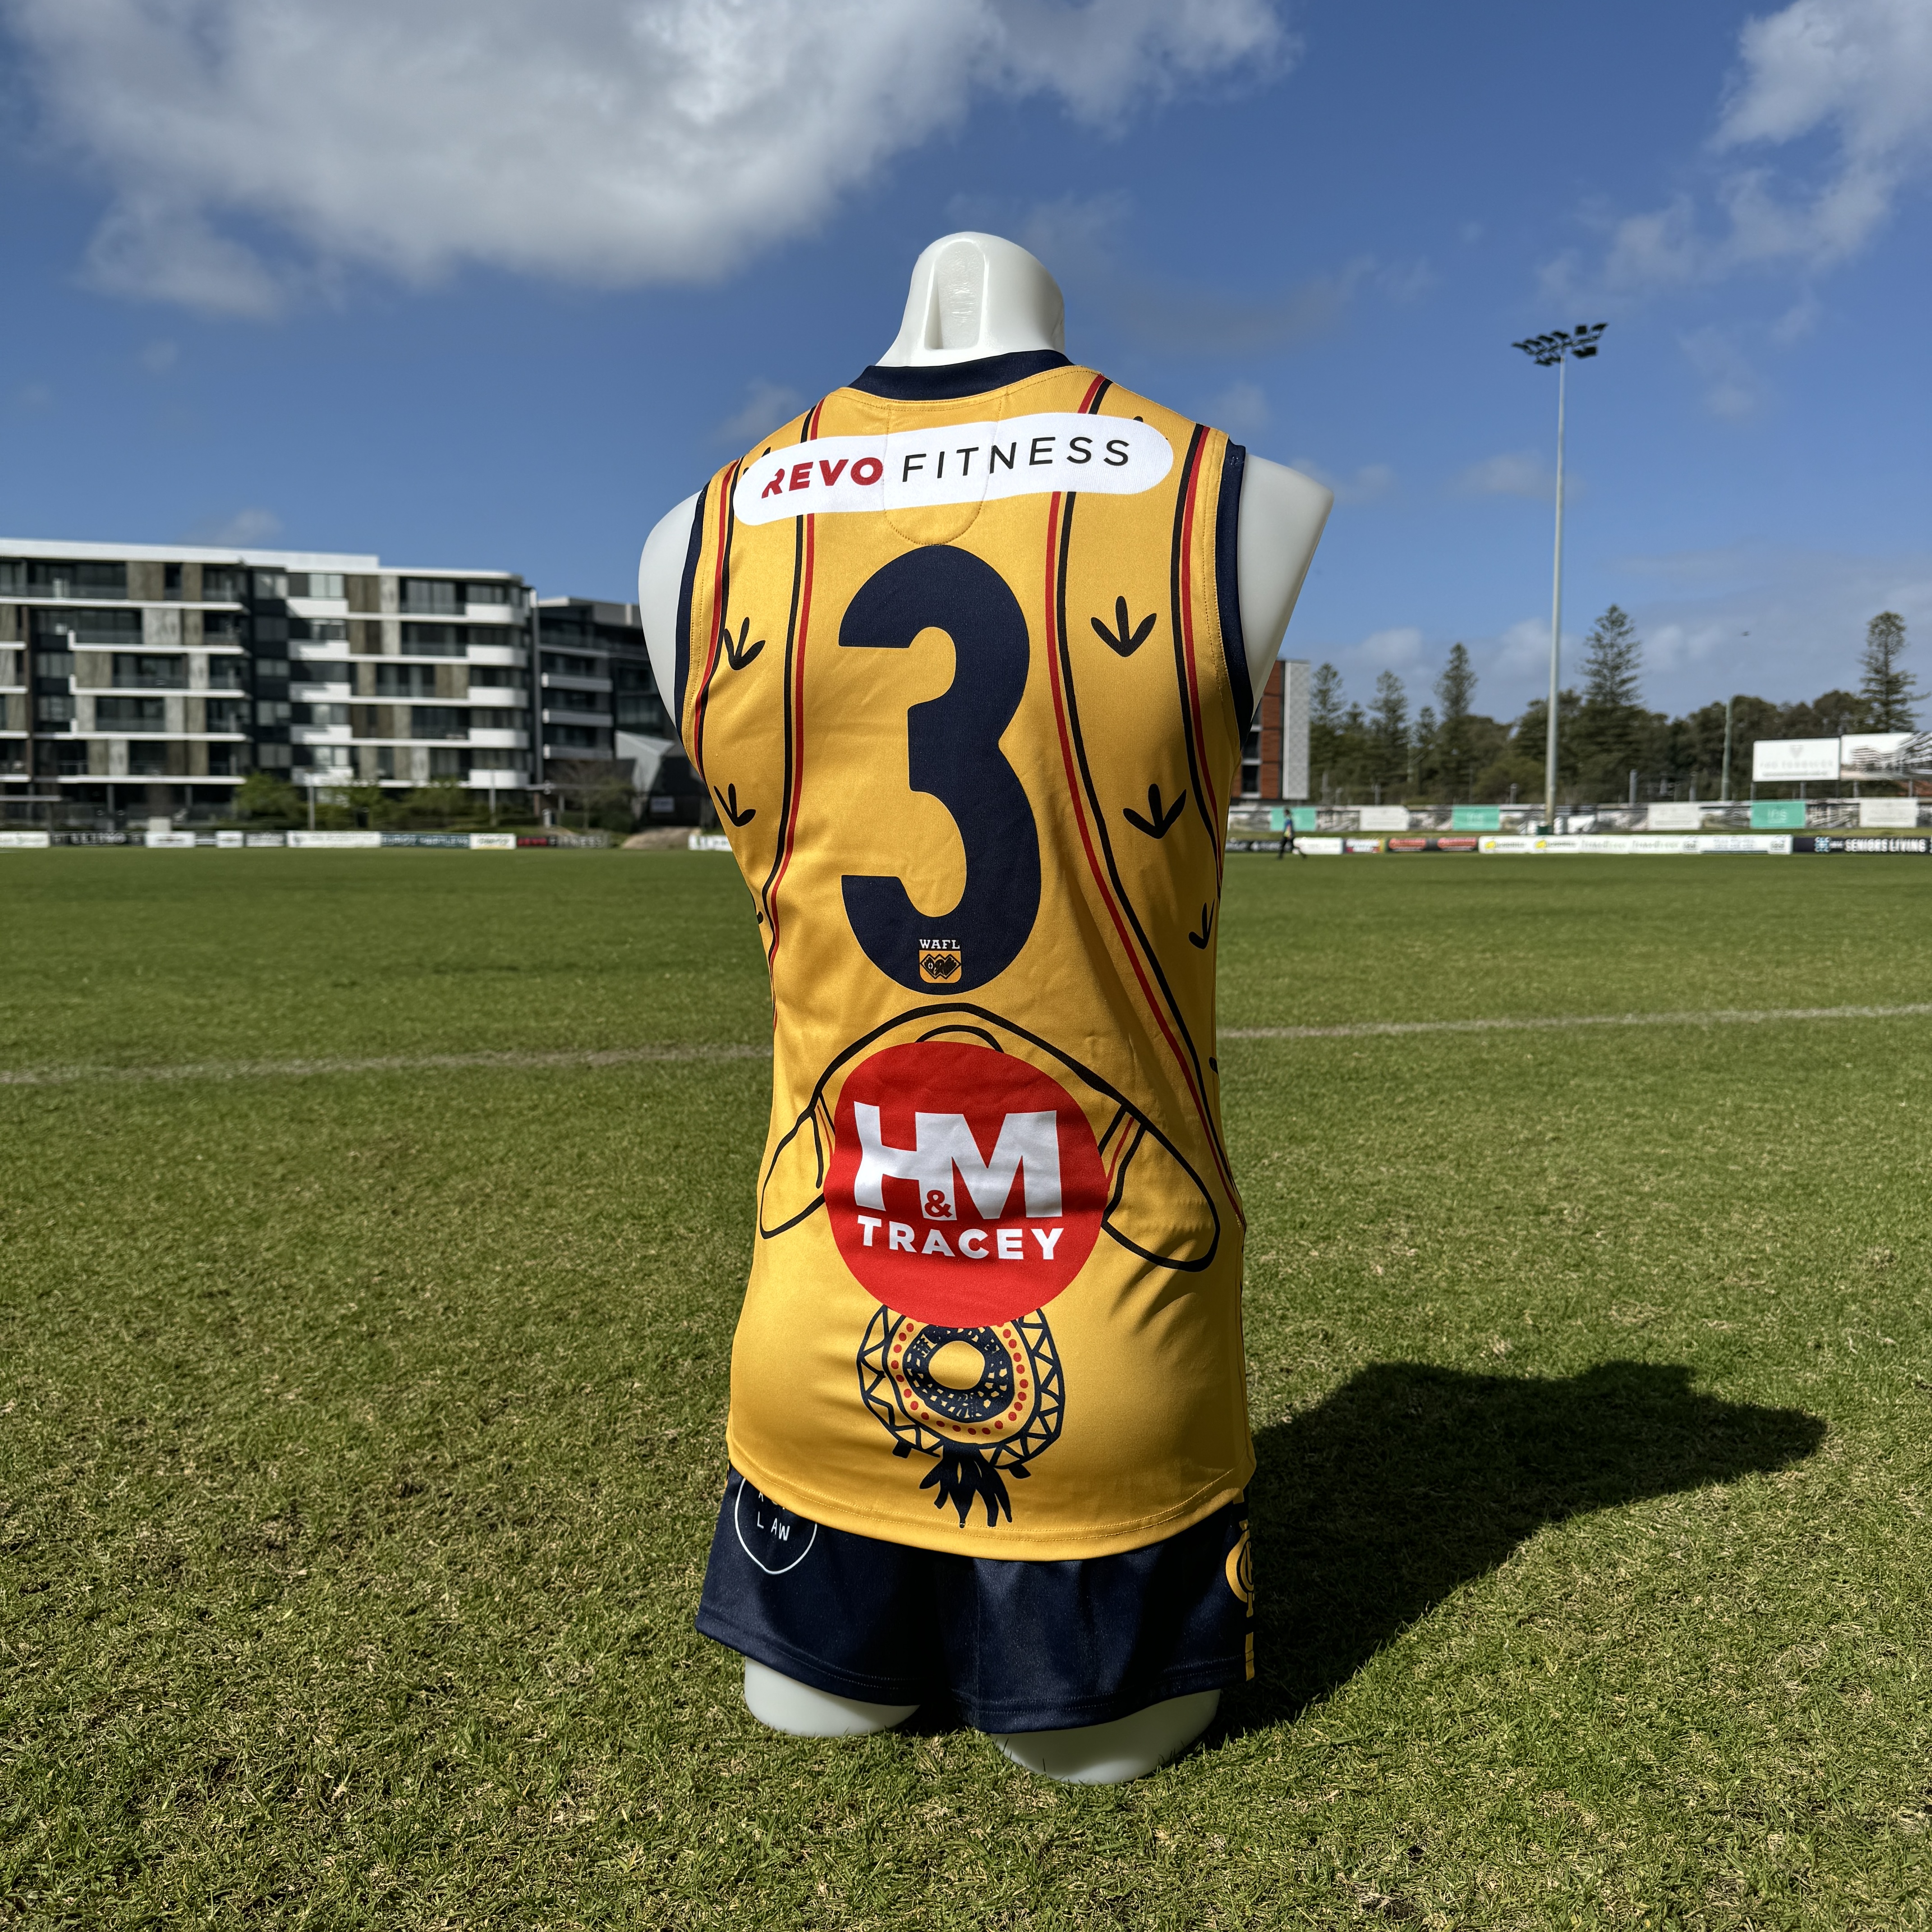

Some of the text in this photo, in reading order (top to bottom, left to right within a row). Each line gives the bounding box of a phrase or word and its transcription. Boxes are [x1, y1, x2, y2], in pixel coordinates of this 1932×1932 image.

[761, 437, 1130, 498] REVO FITNESS
[838, 545, 1041, 995] 3
[1845, 838, 1888, 852] SENIORS
[1889, 838, 1926, 852] LIVING
[919, 939, 960, 949] WAFL
[857, 1214, 1064, 1260] TRACEY
